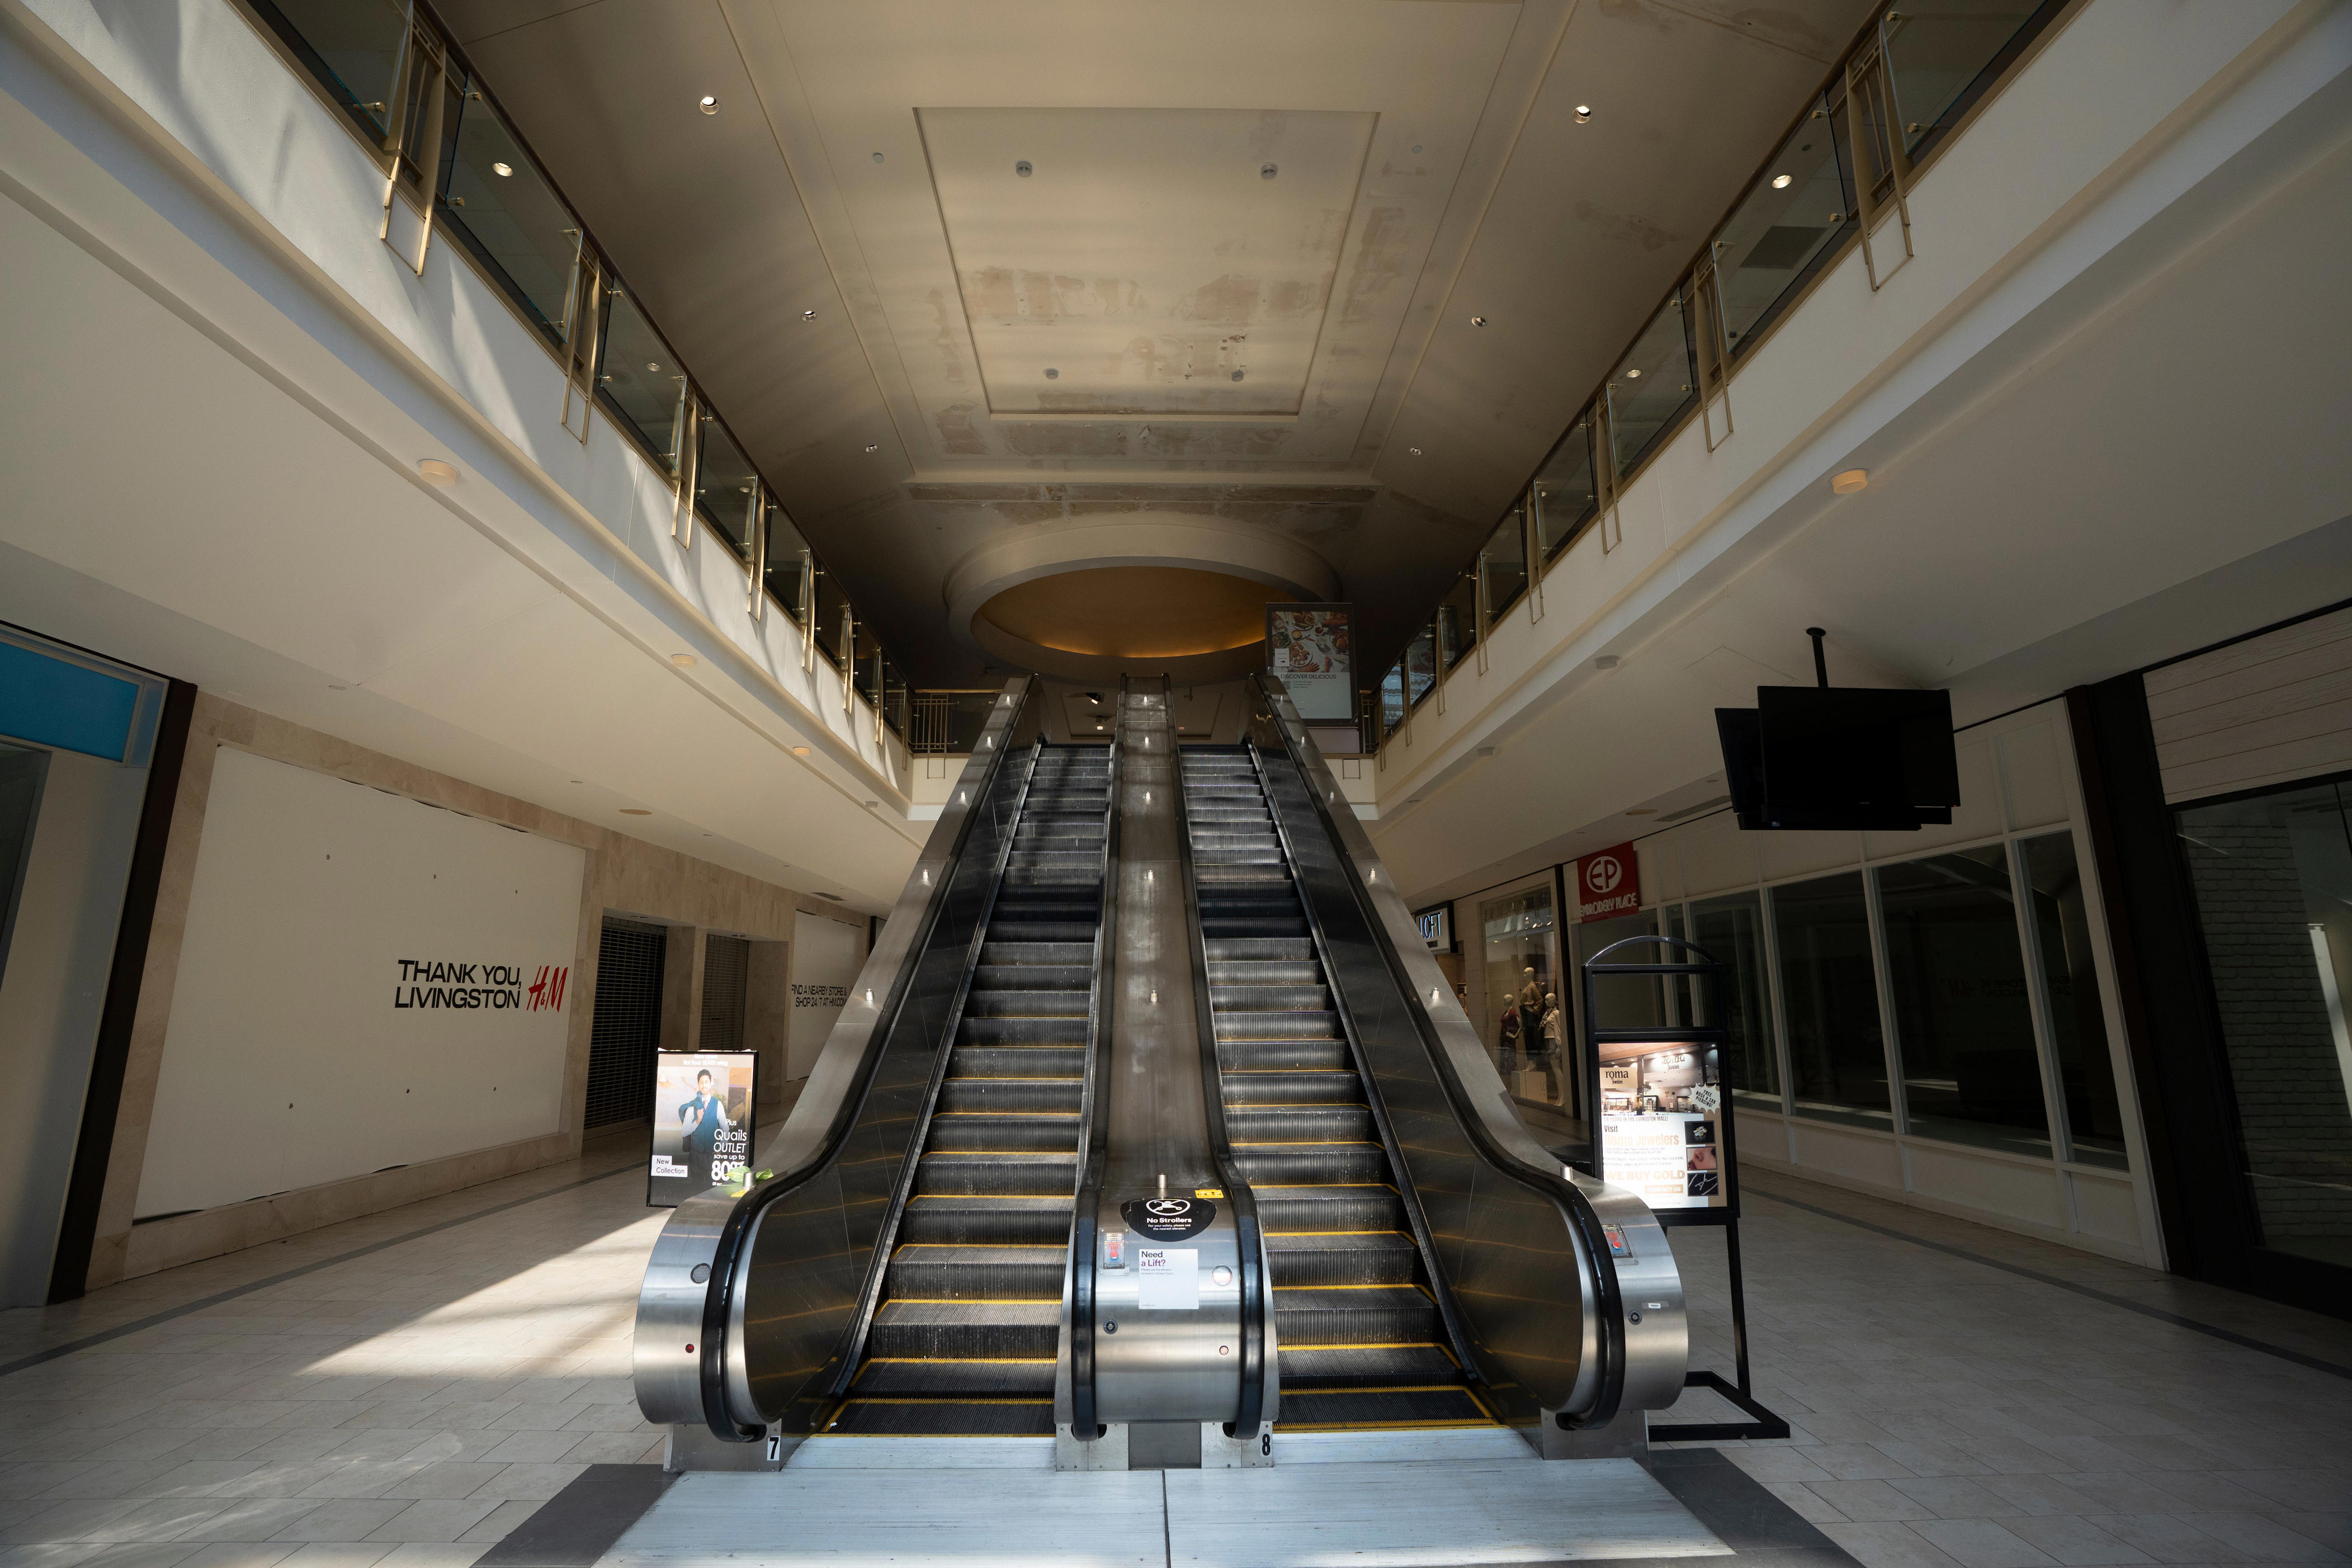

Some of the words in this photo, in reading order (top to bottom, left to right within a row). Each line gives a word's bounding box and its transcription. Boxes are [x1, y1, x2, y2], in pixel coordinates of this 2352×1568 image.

[1616, 892, 1637, 909] PLACE
[1419, 911, 1442, 939] LOFT
[398, 959, 478, 984] THANK
[481, 965, 522, 989] YOU,
[526, 965, 568, 1013] H&M
[791, 984, 803, 995] FIND
[804, 985, 807, 995] A
[808, 985, 828, 995] NEARBY
[829, 986, 843, 996] STORE
[844, 988, 847, 996] &
[394, 986, 521, 1009] LIVINGSTON
[796, 997, 811, 1007] SHOP
[811, 997, 823, 1007] 24/7
[823, 998, 829, 1007] AT
[1605, 1070, 1629, 1079] roma
[1695, 1096, 1713, 1108] PIERCING!
[714, 1128, 747, 1142] Quails
[1636, 1134, 1679, 1146] Jewelers
[714, 1142, 747, 1153] OUTLET
[1605, 1171, 1624, 1180] WE
[1627, 1170, 1651, 1180] BUY
[1653, 1170, 1685, 1180] GOLD
[769, 1437, 779, 1460] 7
[1262, 1433, 1271, 1456] 8
